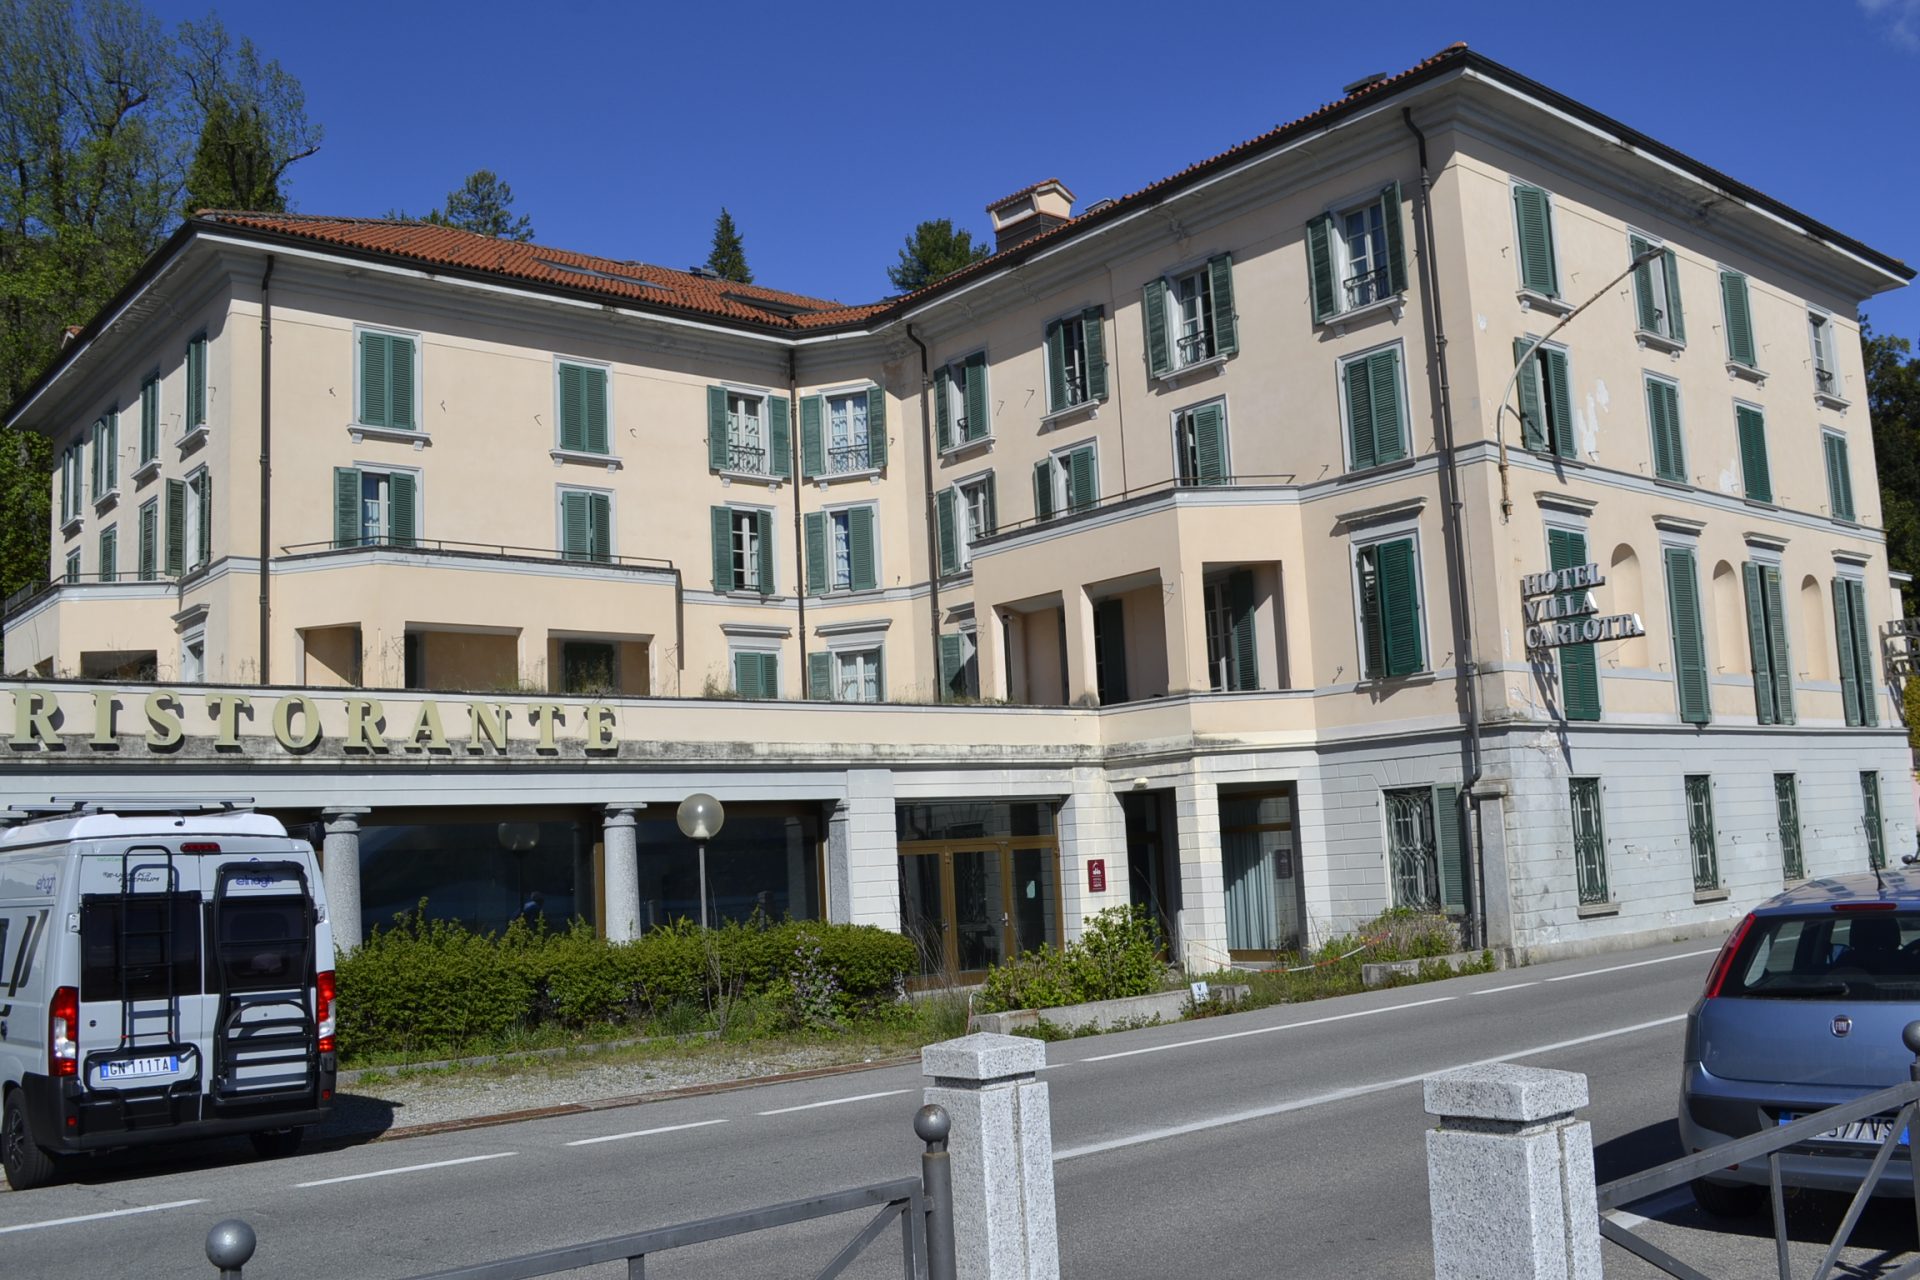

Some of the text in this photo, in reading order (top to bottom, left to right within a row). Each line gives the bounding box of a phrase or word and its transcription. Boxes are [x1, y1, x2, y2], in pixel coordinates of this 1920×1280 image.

[1523, 563, 1605, 597] HOTEL
[1524, 591, 1599, 625] VILLA
[1526, 613, 1645, 650] CARLOTTA
[8, 688, 619, 751] RISTORANTE
[110, 1058, 169, 1076] GN 111TA
